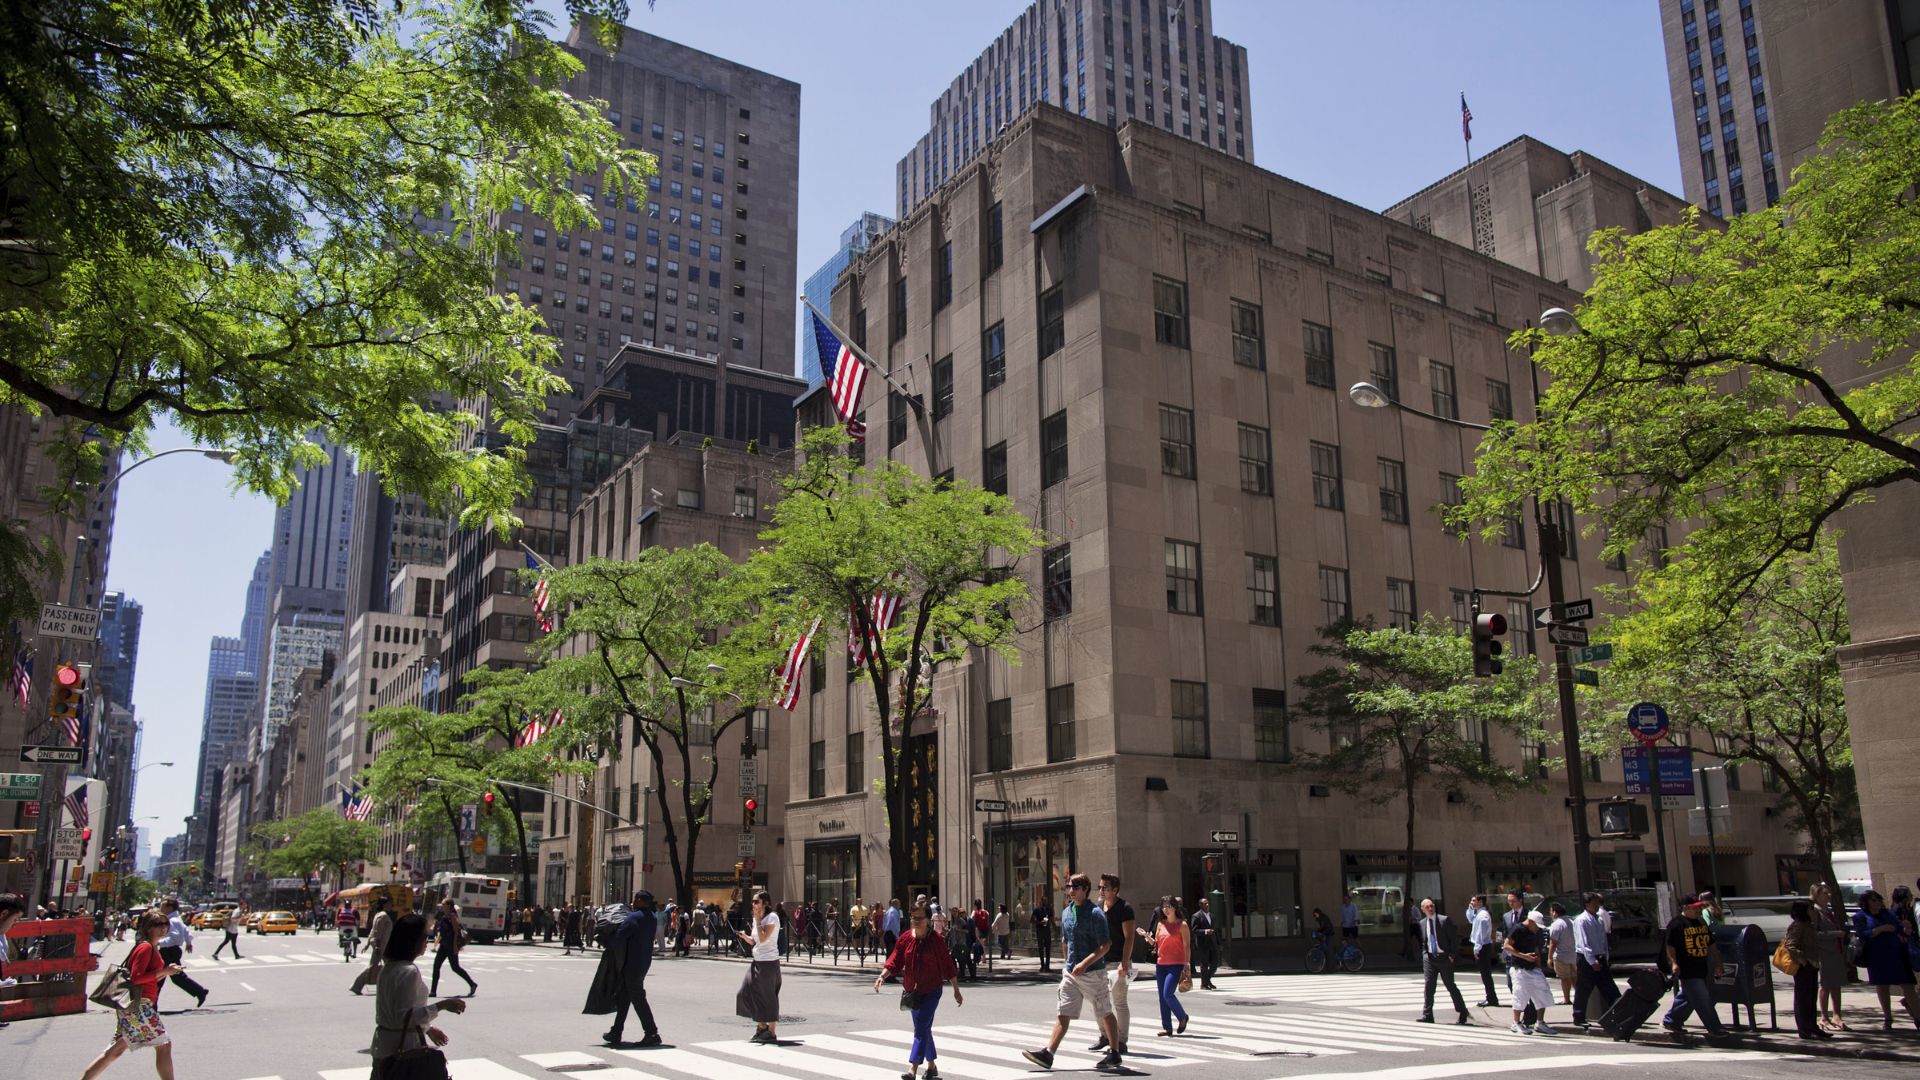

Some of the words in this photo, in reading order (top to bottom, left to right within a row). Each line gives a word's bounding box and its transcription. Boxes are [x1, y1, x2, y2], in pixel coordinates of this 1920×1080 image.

[45, 608, 96, 624] PASSENGER
[1568, 605, 1586, 617] WAY
[42, 620, 66, 633] CARS
[71, 624, 94, 636] ONLY
[1558, 630, 1570, 639] ONE
[1571, 631, 1584, 641] WAY
[1585, 647, 1593, 661] 5
[58, 751, 76, 759] WAY
[1623, 748, 1637, 757] M2
[1624, 760, 1638, 769] M3
[1626, 771, 1640, 781] M5
[1627, 783, 1641, 793] M5
[57, 830, 82, 838] STOP
